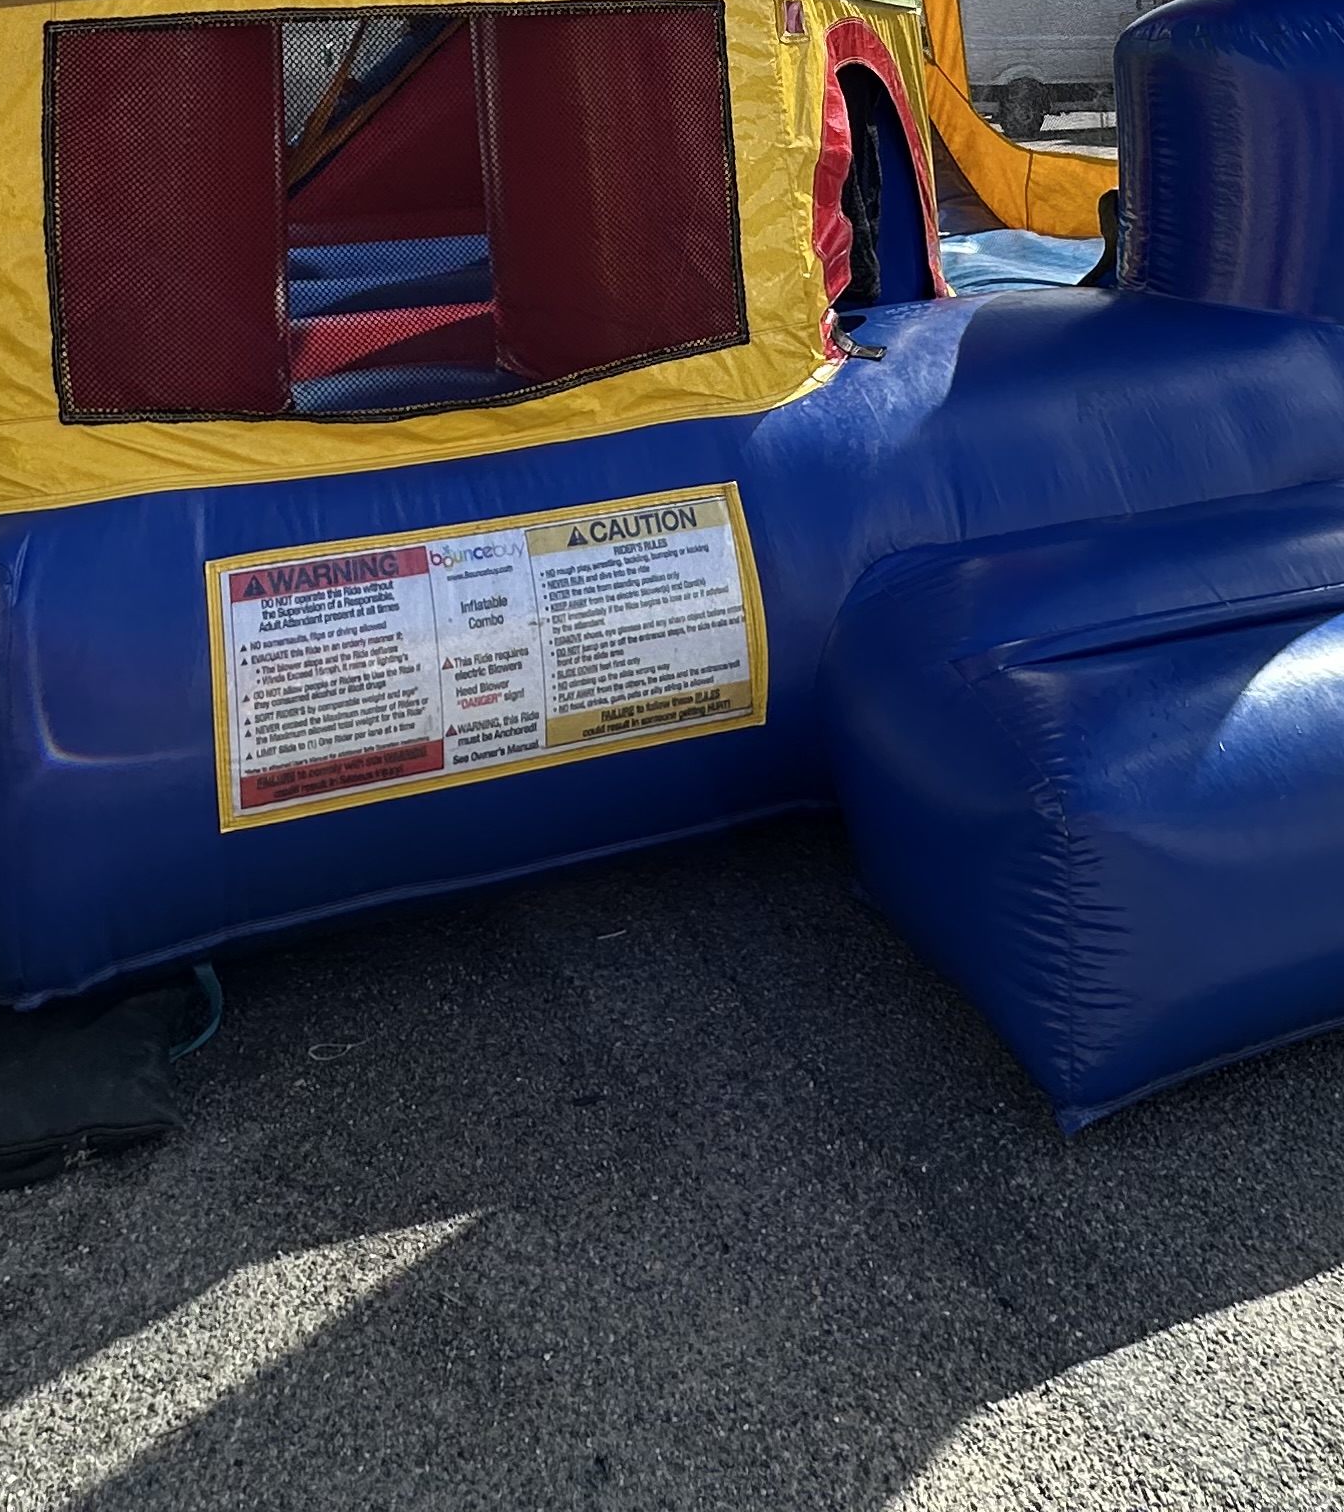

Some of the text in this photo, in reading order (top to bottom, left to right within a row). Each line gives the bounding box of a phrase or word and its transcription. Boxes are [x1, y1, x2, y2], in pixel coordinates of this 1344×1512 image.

[589, 506, 697, 543] CAUTION
[429, 536, 525, 570] bouncebuy
[613, 538, 668, 555] RIDER'S RULES
[266, 553, 399, 594] WARNING
[261, 580, 393, 609] DO NOT operate this Ride without
[460, 594, 507, 614] Inflatable
[259, 619, 281, 632] Adult
[324, 608, 355, 623] present
[356, 606, 364, 617] at
[365, 605, 375, 615] all
[377, 601, 399, 613] times
[262, 608, 275, 620] the
[277, 601, 325, 619] Supervision
[327, 599, 336, 610] of
[336, 600, 341, 608] a
[468, 612, 503, 630] Combo
[453, 644, 528, 669] This Ride requires
[454, 658, 522, 680] electric Blowers
[503, 712, 517, 725] this
[520, 708, 539, 721] Ride
[457, 733, 480, 747] must
[481, 731, 492, 742] be
[452, 738, 538, 765] See Owner's Manual
